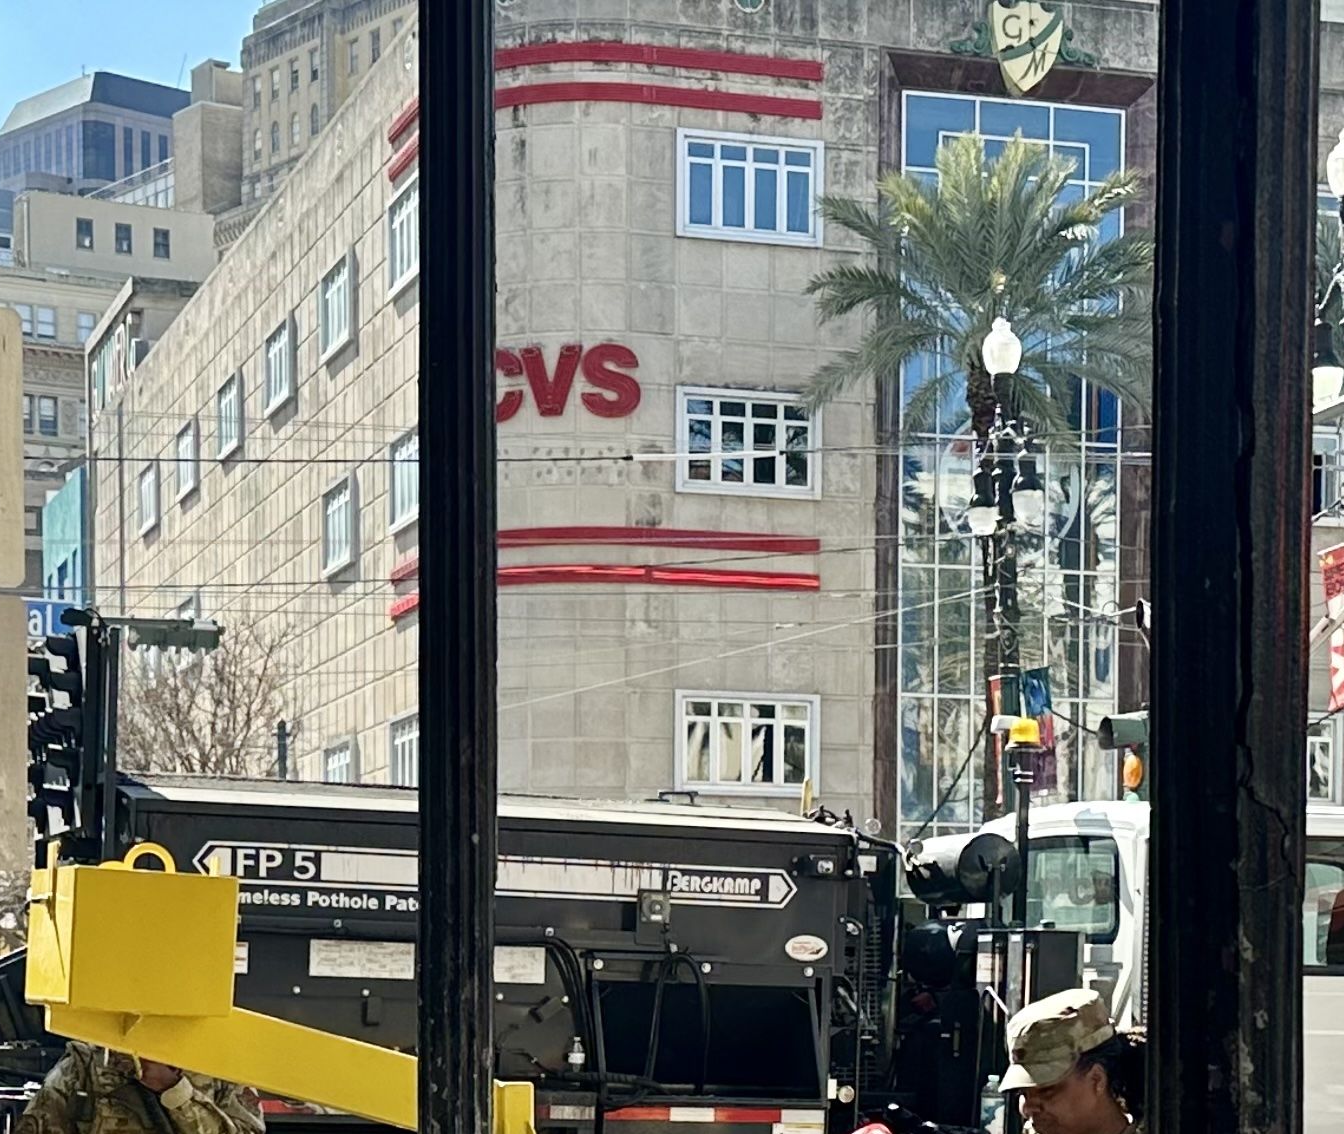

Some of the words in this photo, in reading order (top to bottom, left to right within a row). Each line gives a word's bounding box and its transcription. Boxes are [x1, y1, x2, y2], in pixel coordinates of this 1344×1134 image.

[235, 848, 284, 878] FP
[292, 851, 317, 880] 5
[666, 869, 762, 895] BERGKAMP
[238, 889, 302, 906] meless
[306, 890, 379, 910] Pothole
